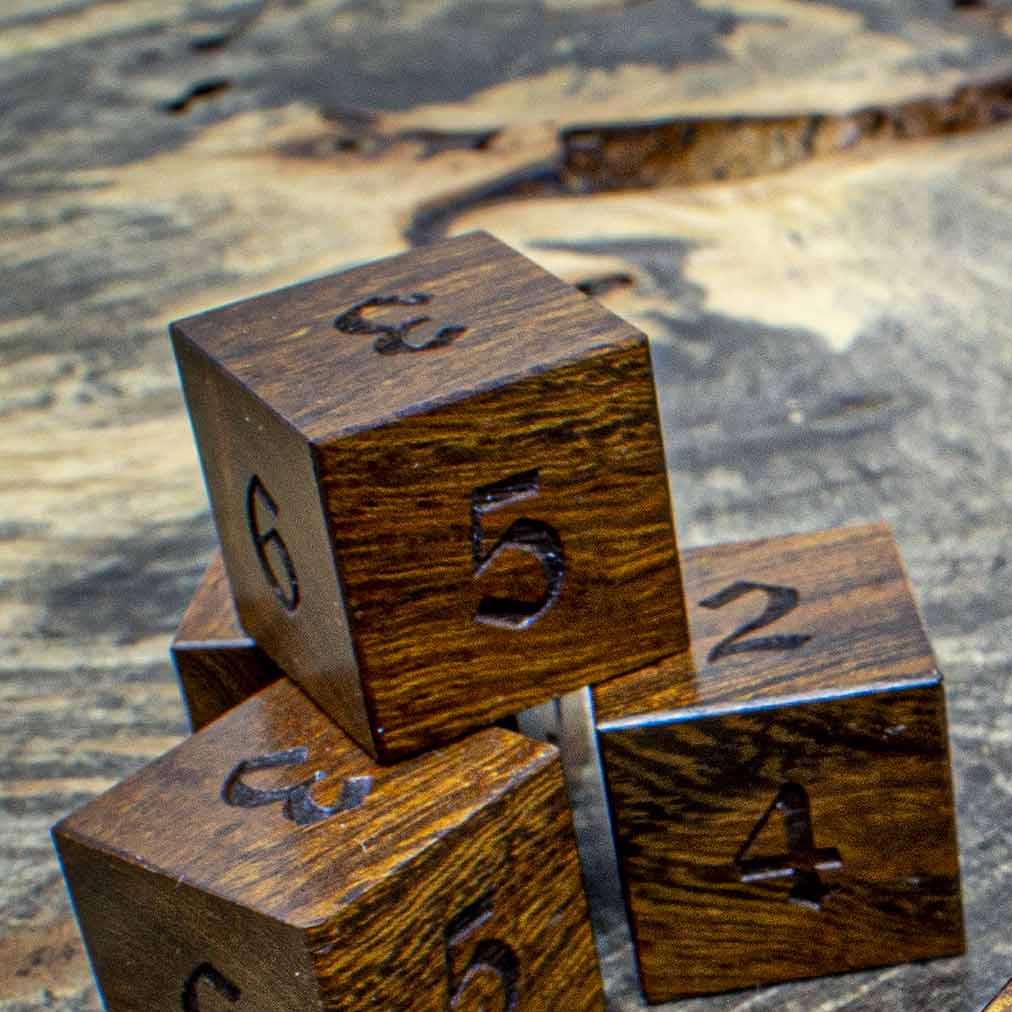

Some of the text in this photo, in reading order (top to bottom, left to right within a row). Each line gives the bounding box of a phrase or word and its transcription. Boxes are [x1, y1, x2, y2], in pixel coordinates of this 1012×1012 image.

[334, 293, 468, 355] 3
[247, 474, 298, 615] 6
[471, 468, 565, 630] 5
[699, 581, 812, 661] 2
[221, 747, 375, 825] 3
[735, 781, 843, 911] 4
